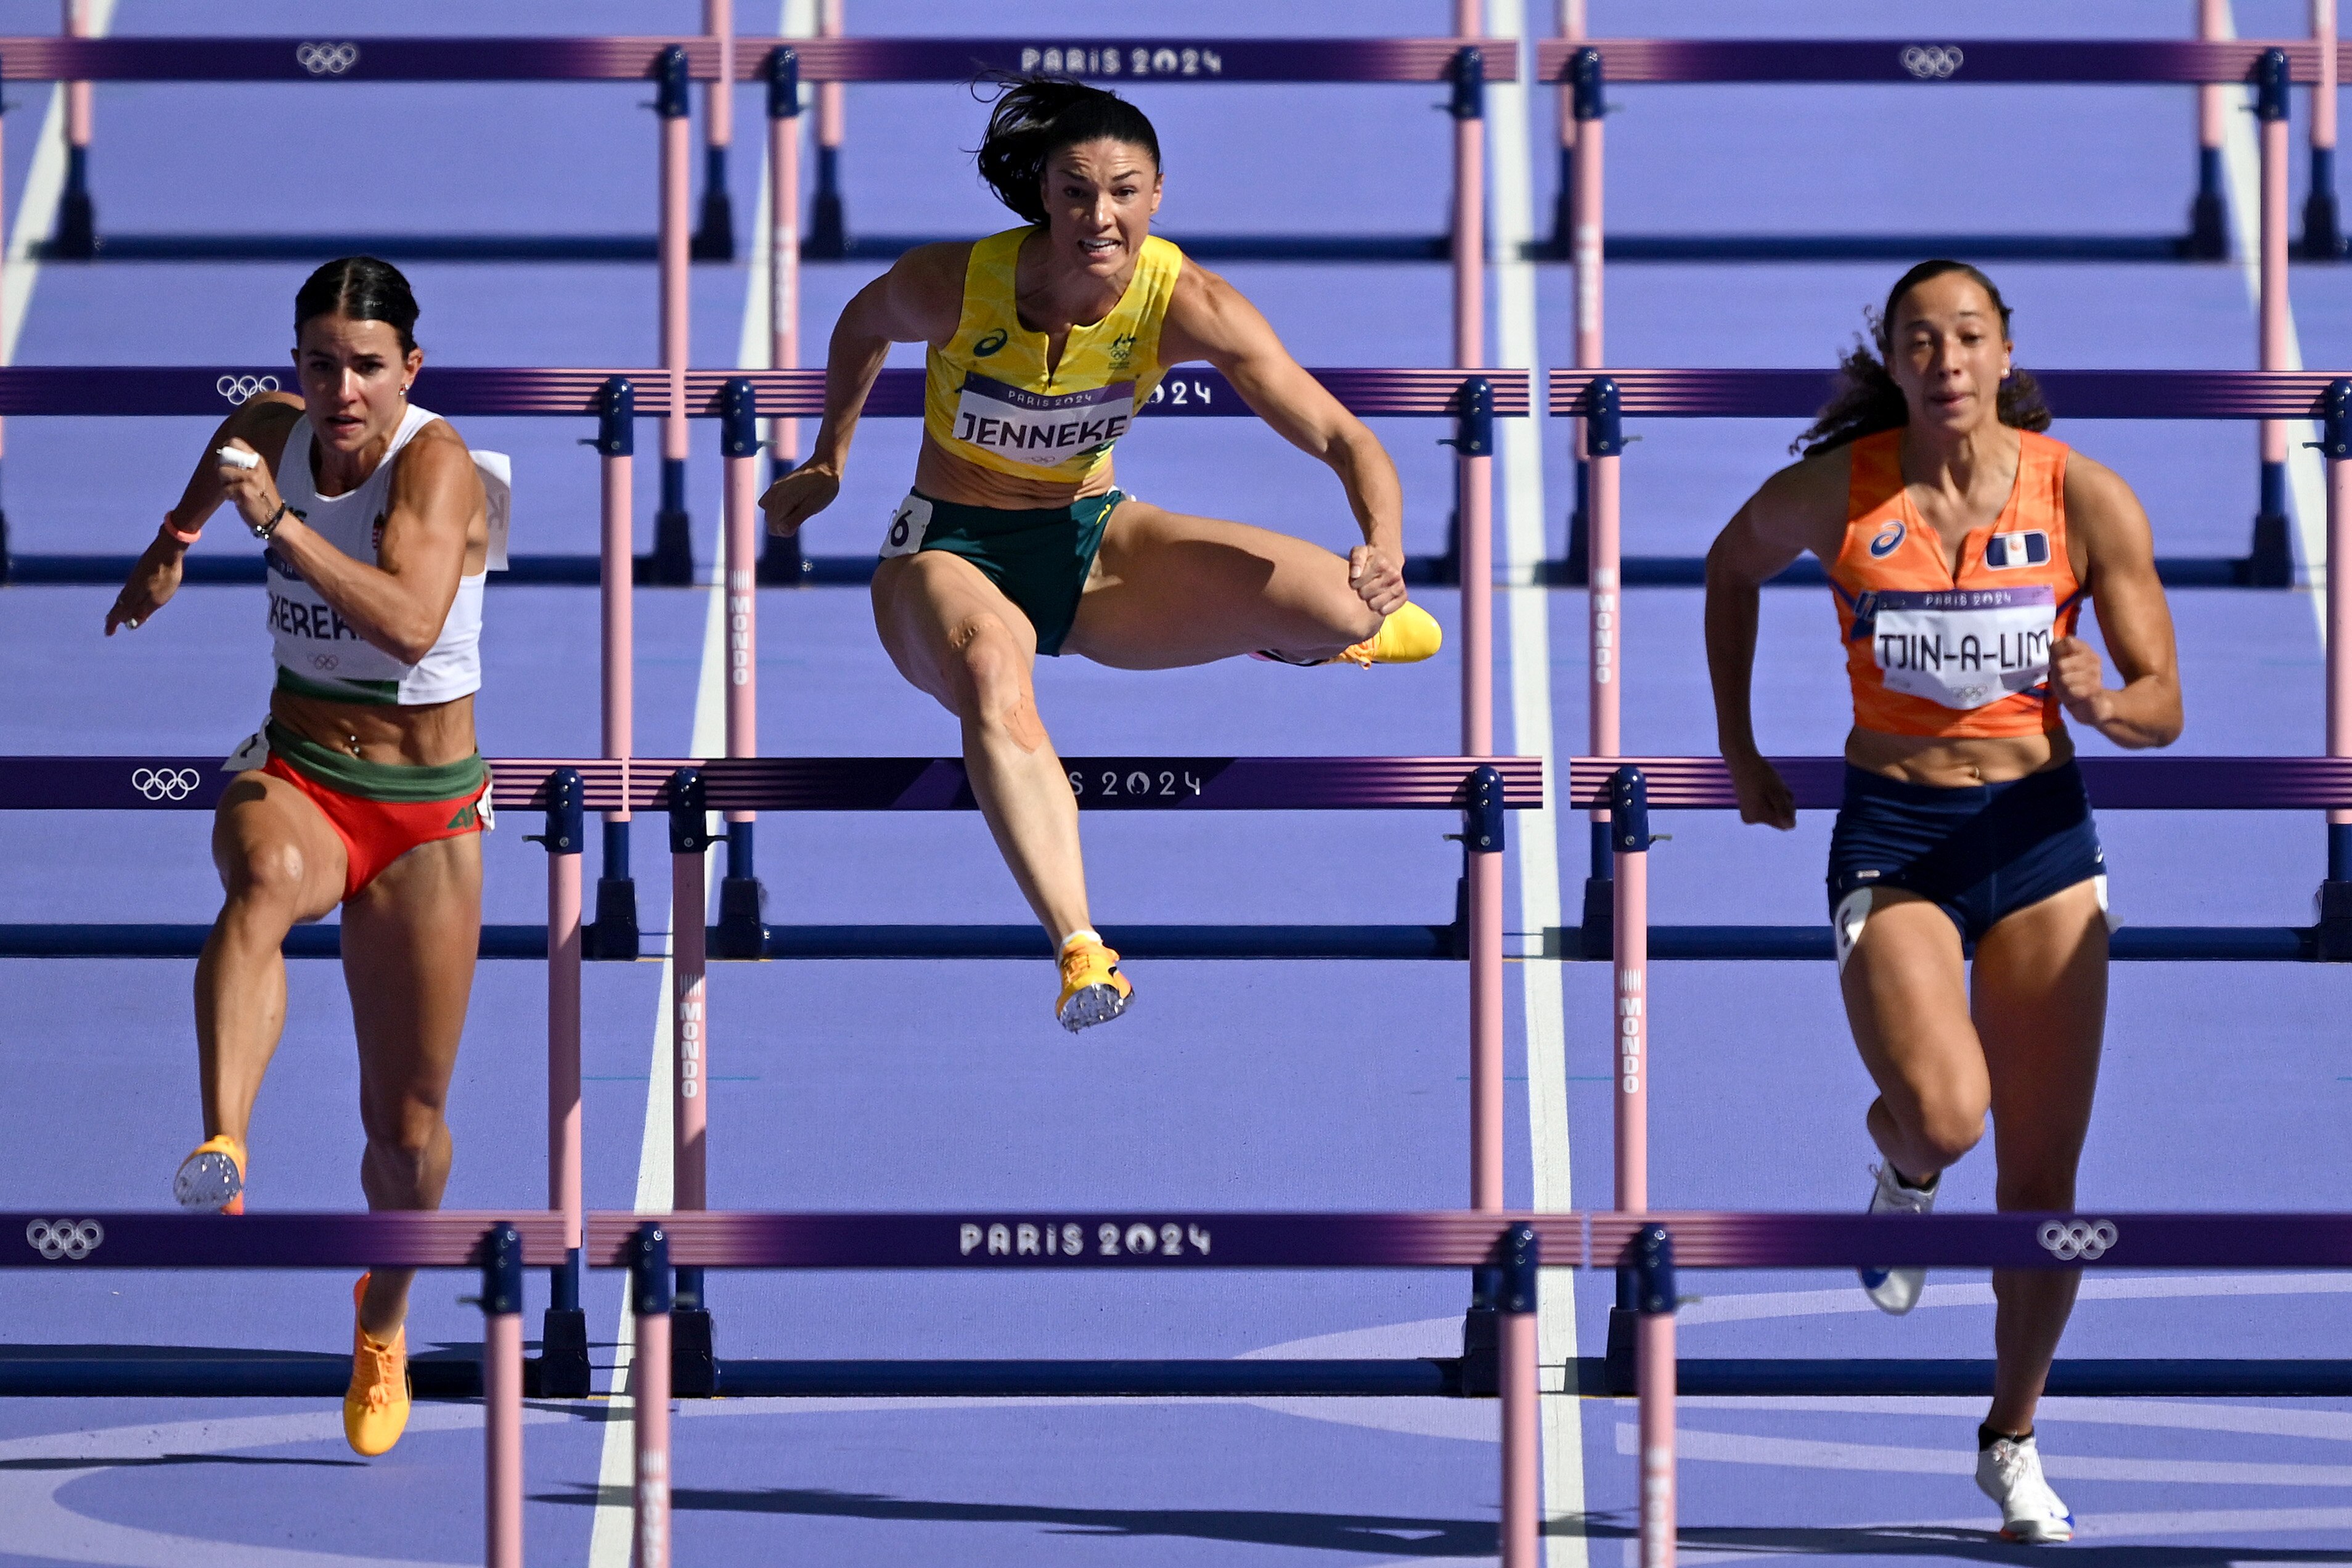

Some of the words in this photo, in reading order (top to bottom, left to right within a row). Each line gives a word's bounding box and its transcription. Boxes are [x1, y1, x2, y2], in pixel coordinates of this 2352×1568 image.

[1132, 47, 1222, 75] 2024
[1008, 390, 1049, 407] PARIS
[1055, 394, 1092, 406] 2024
[1146, 380, 1211, 404] 024
[958, 415, 1127, 449] JENNEKE
[891, 509, 912, 547] 6
[269, 591, 364, 640] KEREK
[1925, 592, 1967, 606] PARIS
[1972, 591, 2011, 606] 2024
[730, 595, 749, 685] MONDO
[1879, 629, 2049, 672] TJIN-A-LIM
[1101, 771, 1201, 795] 2024
[680, 1002, 701, 1098] MONDO
[1620, 997, 1641, 1093] MONDO
[960, 1222, 1084, 1256] PARIS
[1098, 1222, 1211, 1256] 2024
